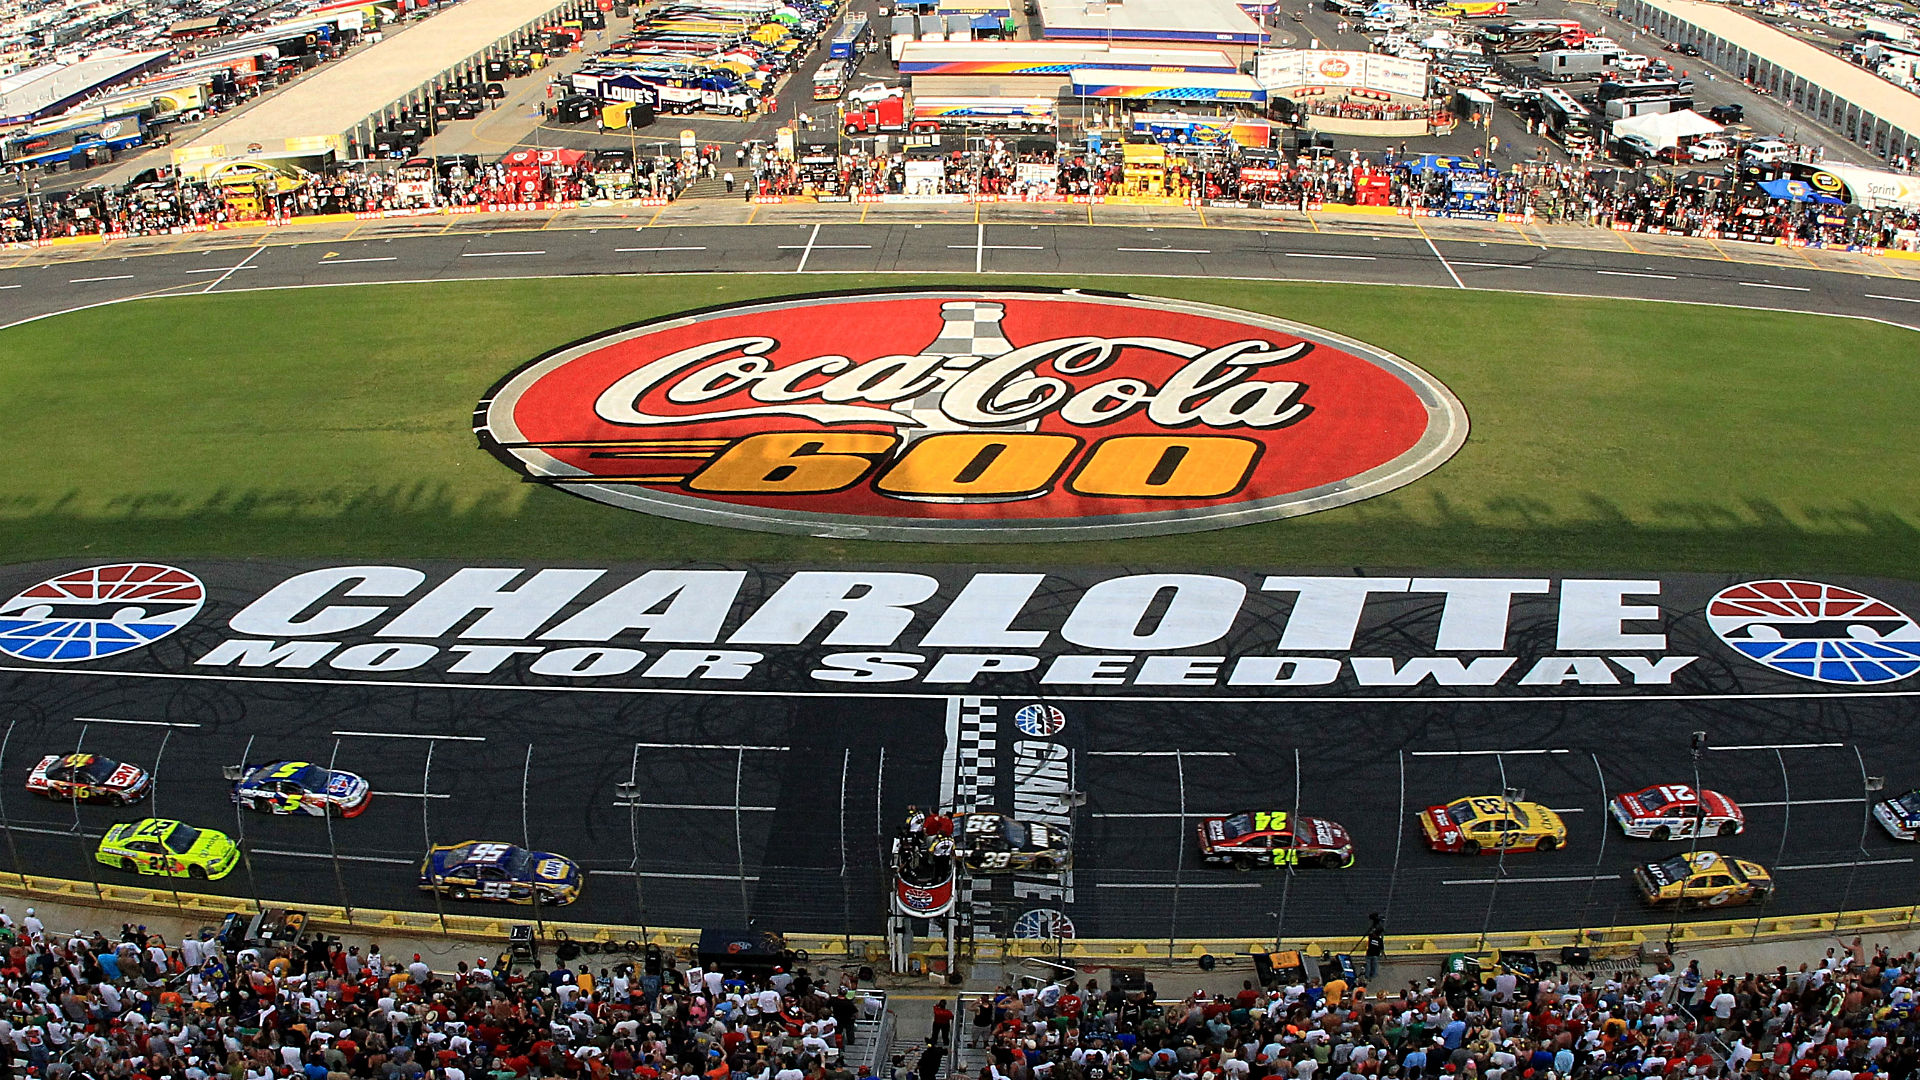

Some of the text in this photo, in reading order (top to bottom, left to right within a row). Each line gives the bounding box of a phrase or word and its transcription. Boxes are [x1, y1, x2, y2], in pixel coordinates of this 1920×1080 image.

[603, 82, 656, 104] LOWE'S
[1216, 91, 1252, 99] SUNOCO
[408, 184, 424, 193] 3M
[1867, 182, 1896, 196] Sprint
[1741, 208, 1764, 216] SPEED
[594, 335, 1313, 428] Coca-Cola
[686, 433, 1261, 497] 600
[228, 565, 1667, 651] CHARLOTTE
[193, 638, 1699, 687] MOTOR SPEEDWAY
[111, 765, 137, 785] 3M
[270, 761, 310, 778] 5
[1659, 784, 1696, 802] 21
[283, 794, 303, 811] 5
[1255, 811, 1287, 831] 24
[1495, 832, 1521, 848] 33
[979, 851, 1012, 869] 39
[1272, 848, 1299, 866] 24
[1648, 863, 1670, 887] UPS
[1709, 889, 1730, 906] 6
